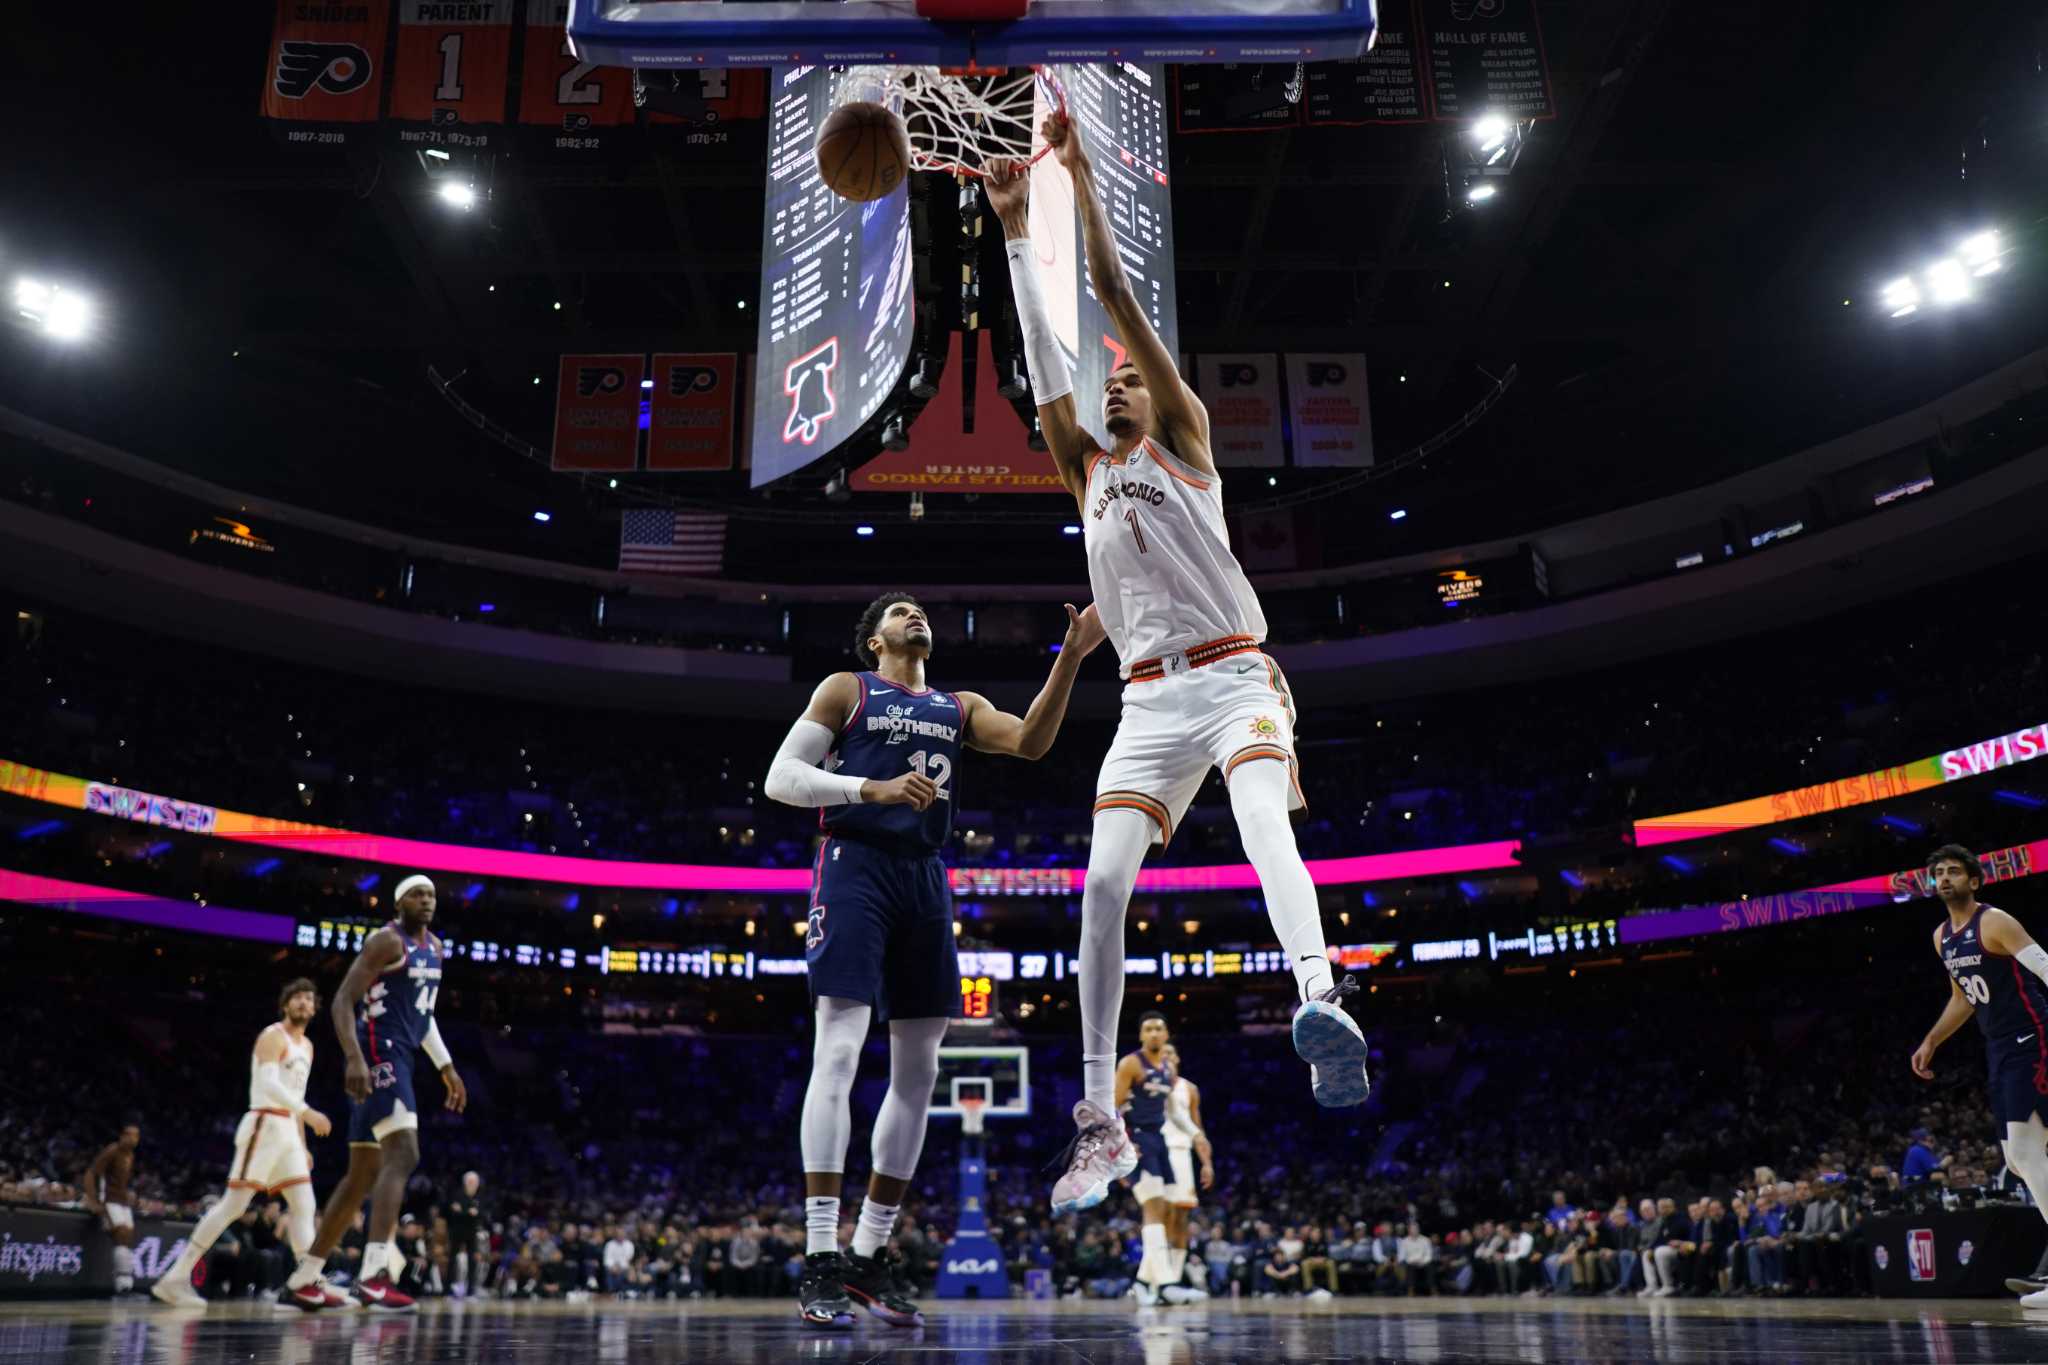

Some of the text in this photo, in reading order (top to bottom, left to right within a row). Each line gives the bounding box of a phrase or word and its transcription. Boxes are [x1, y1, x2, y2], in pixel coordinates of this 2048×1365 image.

[417, 4, 494, 21] PARENT
[1434, 32, 1528, 44] HALL OF FAME
[434, 33, 463, 101] 1
[1120, 100, 1129, 110] 10
[1154, 110, 1160, 119] 2
[784, 106, 807, 125] MAXEY
[1141, 230, 1162, 249] TO 2
[792, 247, 812, 265] TEAM
[773, 278, 787, 291] PTS
[924, 464, 1011, 475] CENTER
[1123, 505, 1148, 554] 1
[886, 704, 914, 718] City of
[867, 716, 958, 743] BROTHERLY
[907, 750, 952, 801] 12
[1771, 766, 1911, 822] SWISH!
[1958, 974, 1990, 1005] 30
[964, 992, 988, 1018] 13
